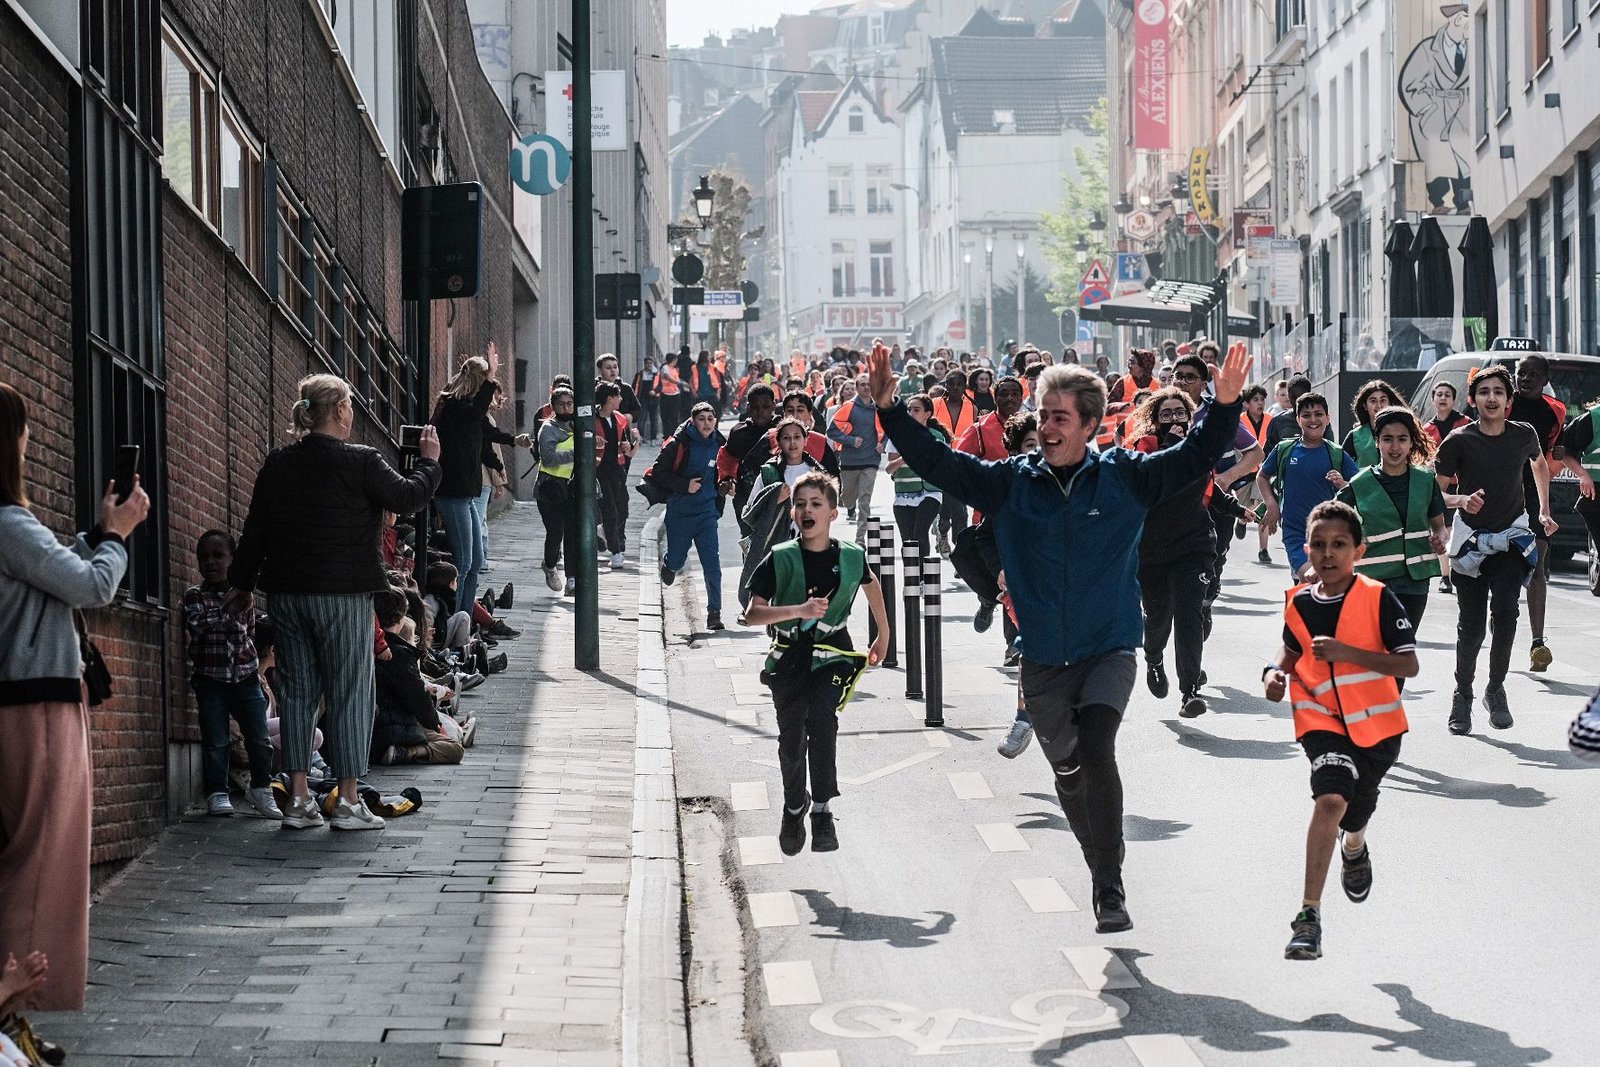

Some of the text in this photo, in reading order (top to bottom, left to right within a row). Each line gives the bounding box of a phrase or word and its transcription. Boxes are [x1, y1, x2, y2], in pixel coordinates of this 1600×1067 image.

[1151, 38, 1166, 125] ALEXIENS
[1192, 155, 1207, 212] SNACK
[827, 307, 900, 327] FORST
[1503, 340, 1529, 349] TAXI
